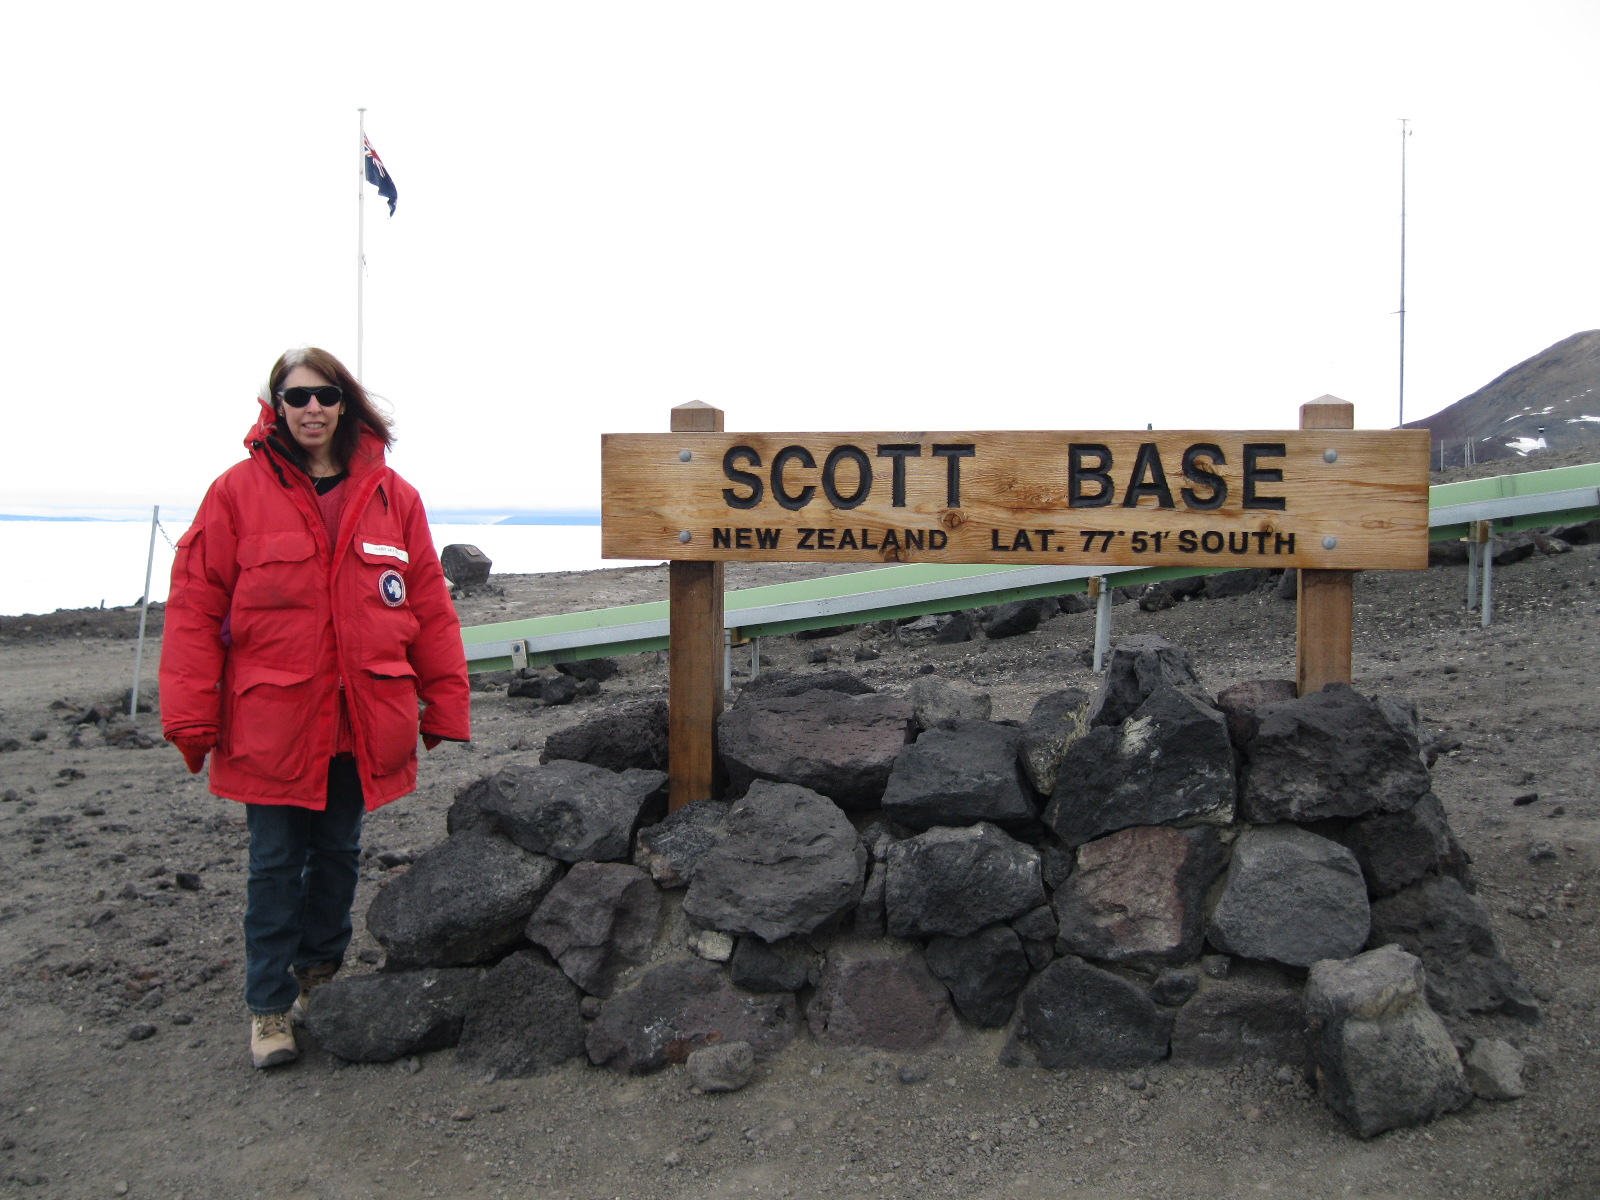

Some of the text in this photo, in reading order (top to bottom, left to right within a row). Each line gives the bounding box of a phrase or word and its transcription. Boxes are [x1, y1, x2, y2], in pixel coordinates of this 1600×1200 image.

[721, 443, 1286, 511] SCOTT BASE
[712, 528, 783, 550] NEW
[797, 528, 948, 551] ZEALAND
[991, 529, 1065, 552] LAT.
[1177, 530, 1295, 555] SOUTH
